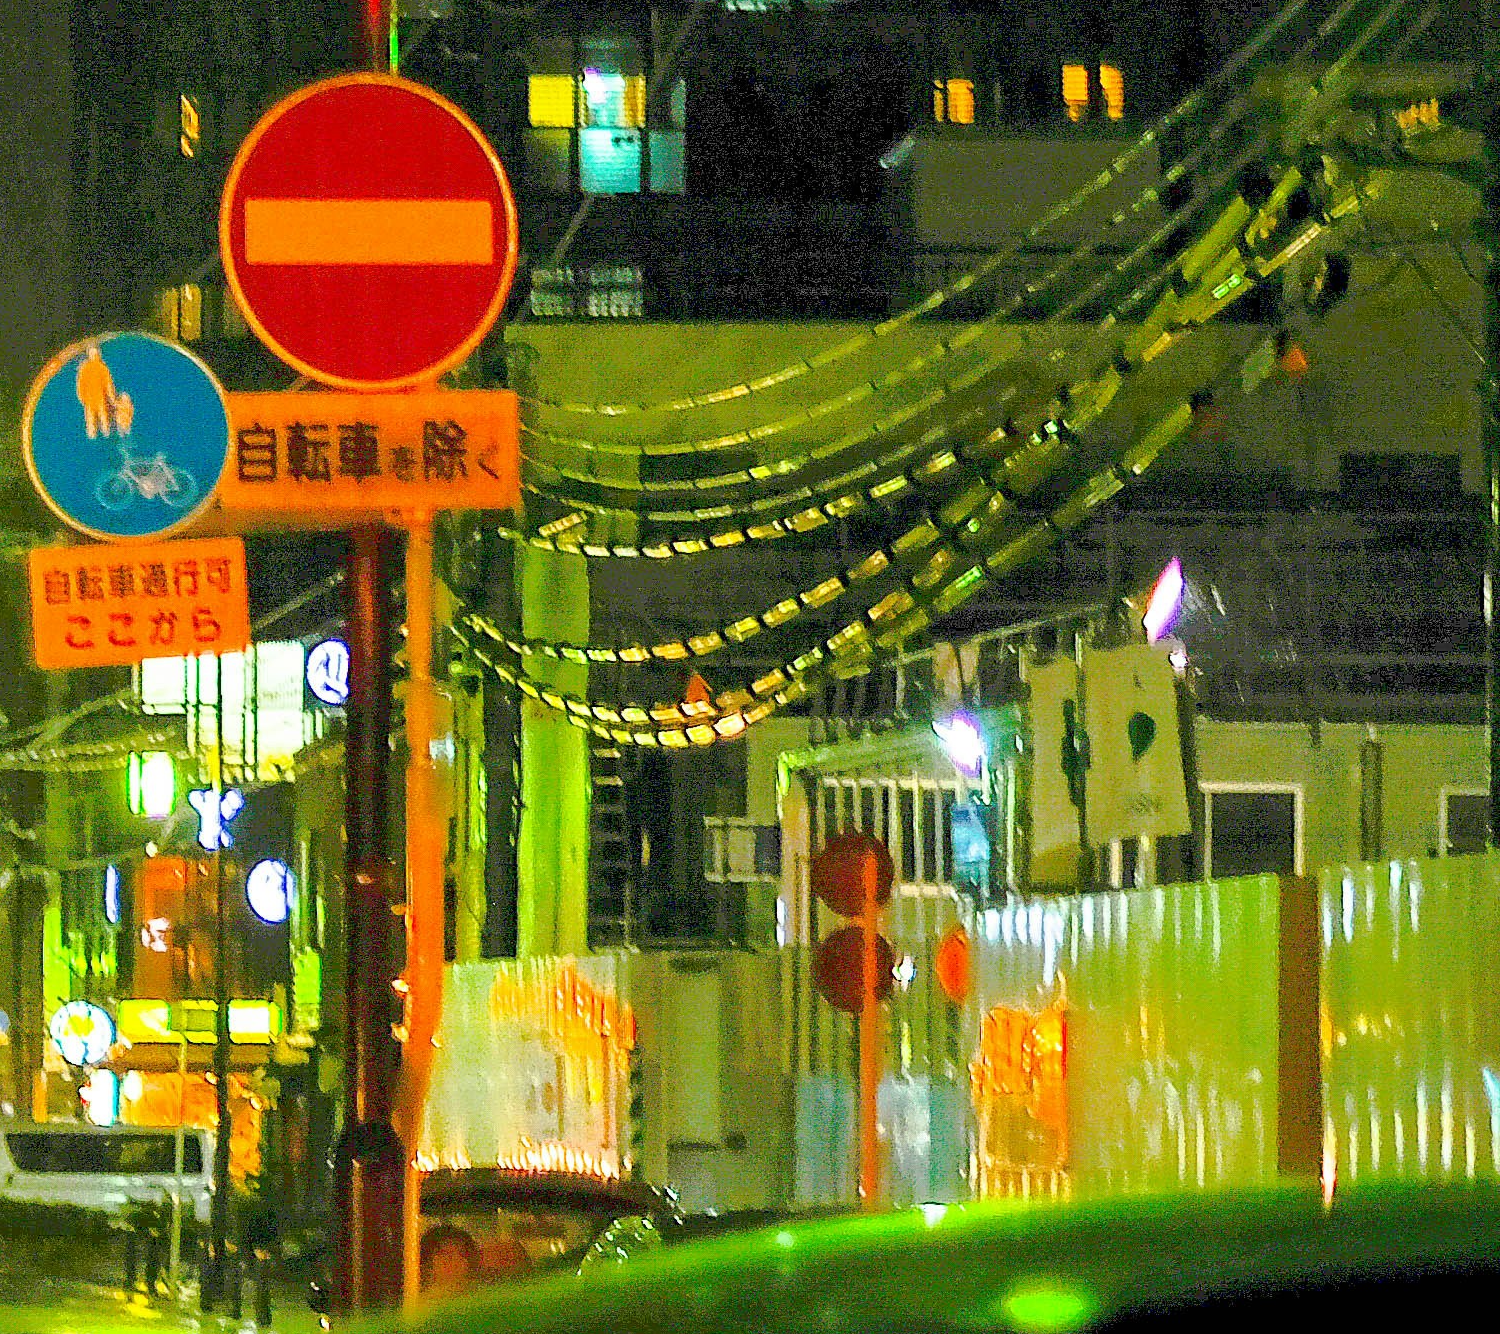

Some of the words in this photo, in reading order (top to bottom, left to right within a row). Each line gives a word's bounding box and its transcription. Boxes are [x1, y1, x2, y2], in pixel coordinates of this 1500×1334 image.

[236, 419, 500, 484] 自転車を除く
[43, 557, 232, 605] 自転車通行可
[64, 607, 223, 650] ここから
